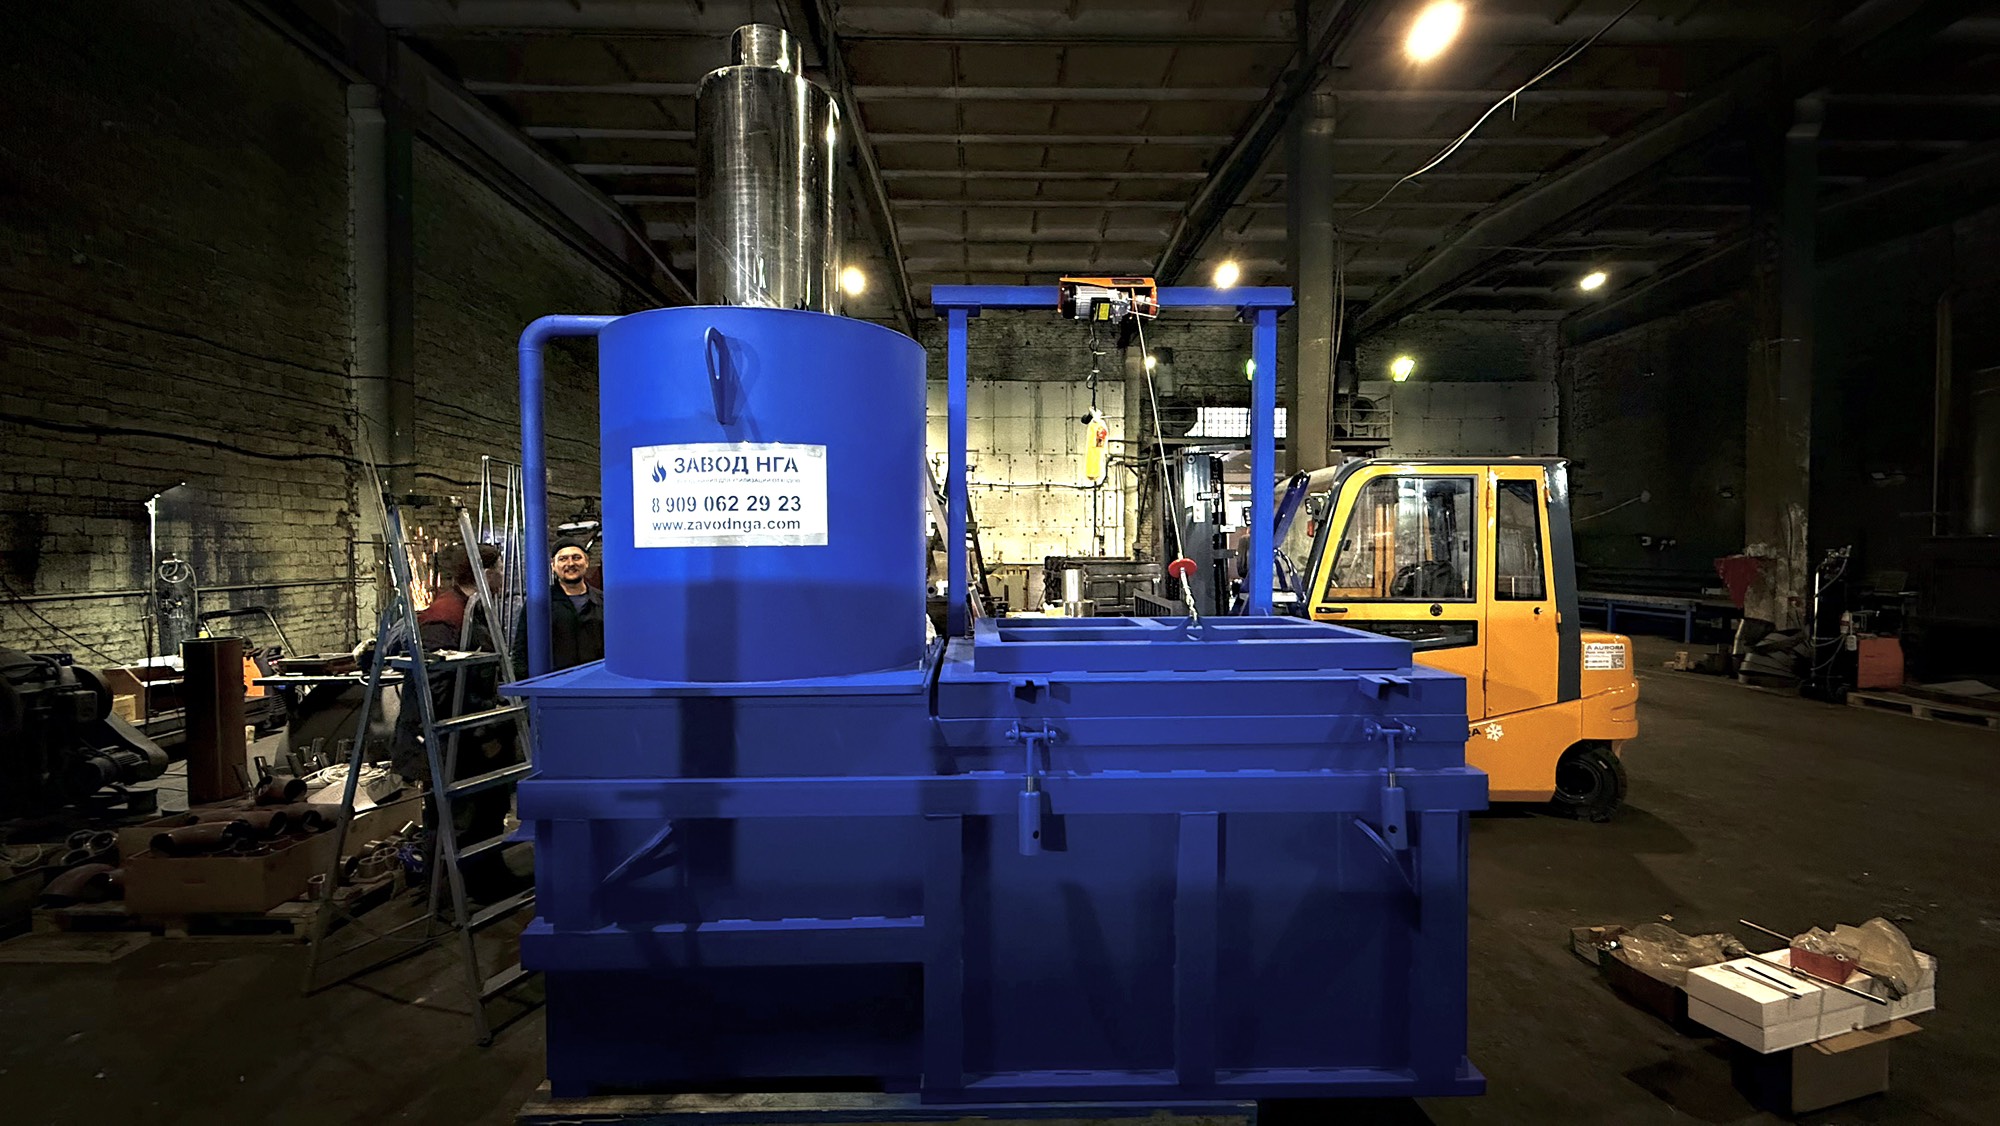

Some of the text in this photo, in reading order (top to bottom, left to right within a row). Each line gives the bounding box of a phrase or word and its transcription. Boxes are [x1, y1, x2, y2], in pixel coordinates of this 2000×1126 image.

[674, 456, 798, 475] ЗАВОД НГА
[652, 496, 801, 513] 8 909 062 29 23
[653, 518, 800, 533] www.zavodnga.com
